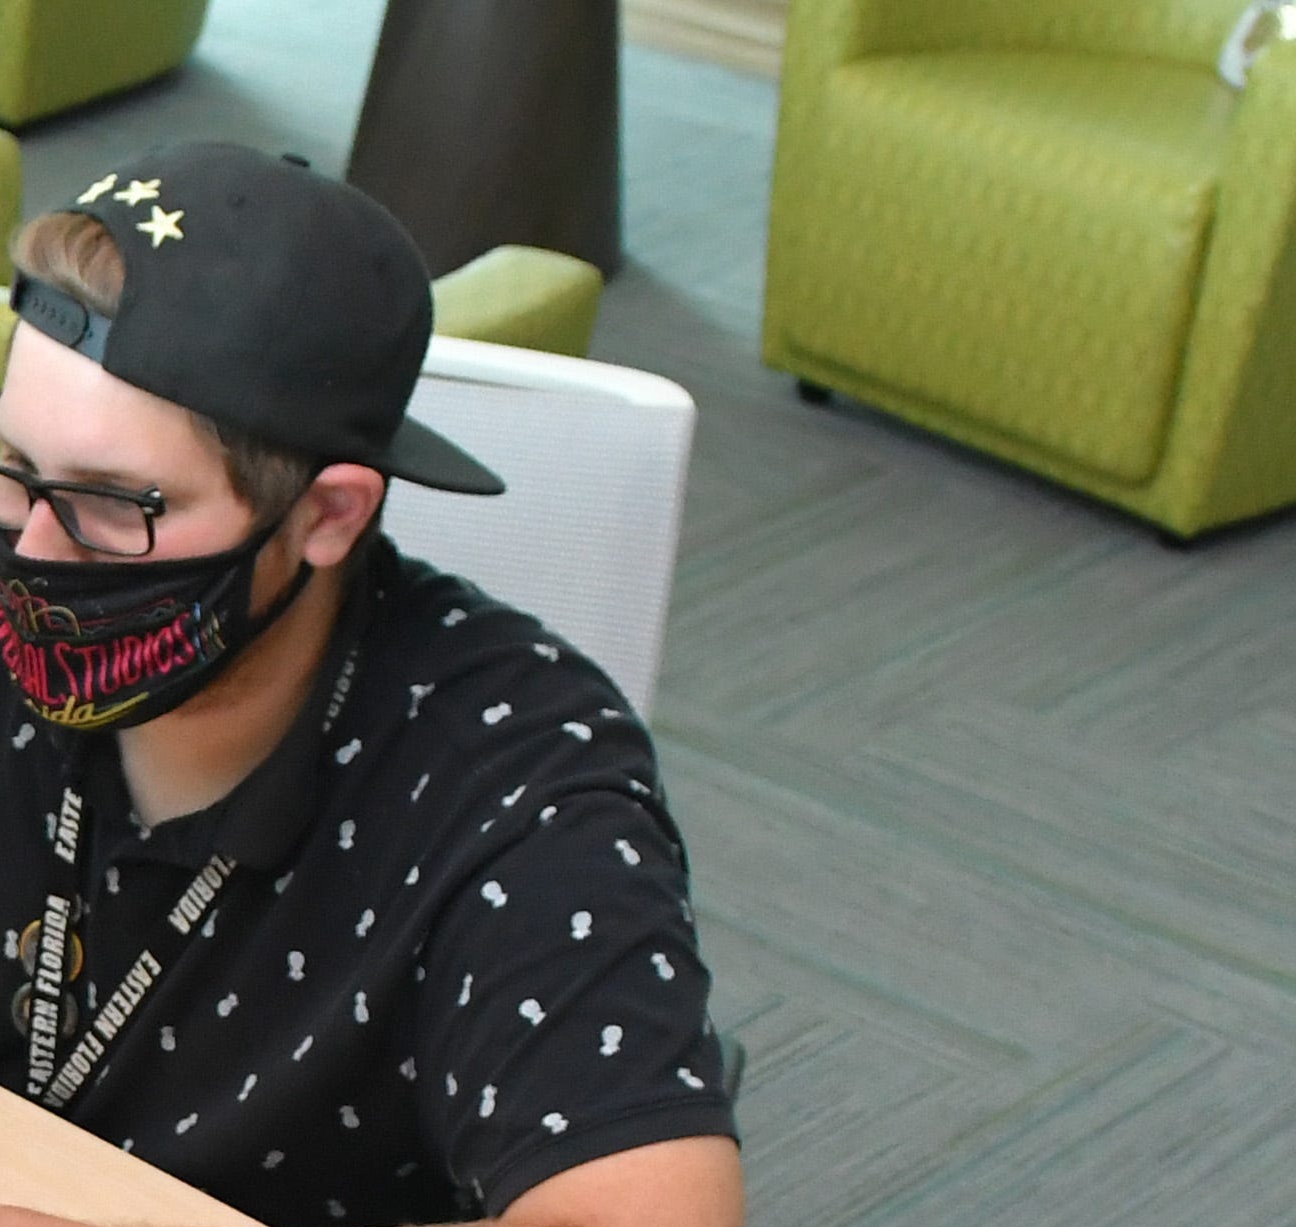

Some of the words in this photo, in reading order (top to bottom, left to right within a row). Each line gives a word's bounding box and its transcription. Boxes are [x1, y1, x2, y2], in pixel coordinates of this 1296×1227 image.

[53, 612, 196, 701] STUDIOS
[54, 786, 83, 865] EASTE
[35, 893, 71, 997] FLORIDA
[94, 949, 162, 1041] EASTERN
[44, 1030, 106, 1108] FLORIDA
